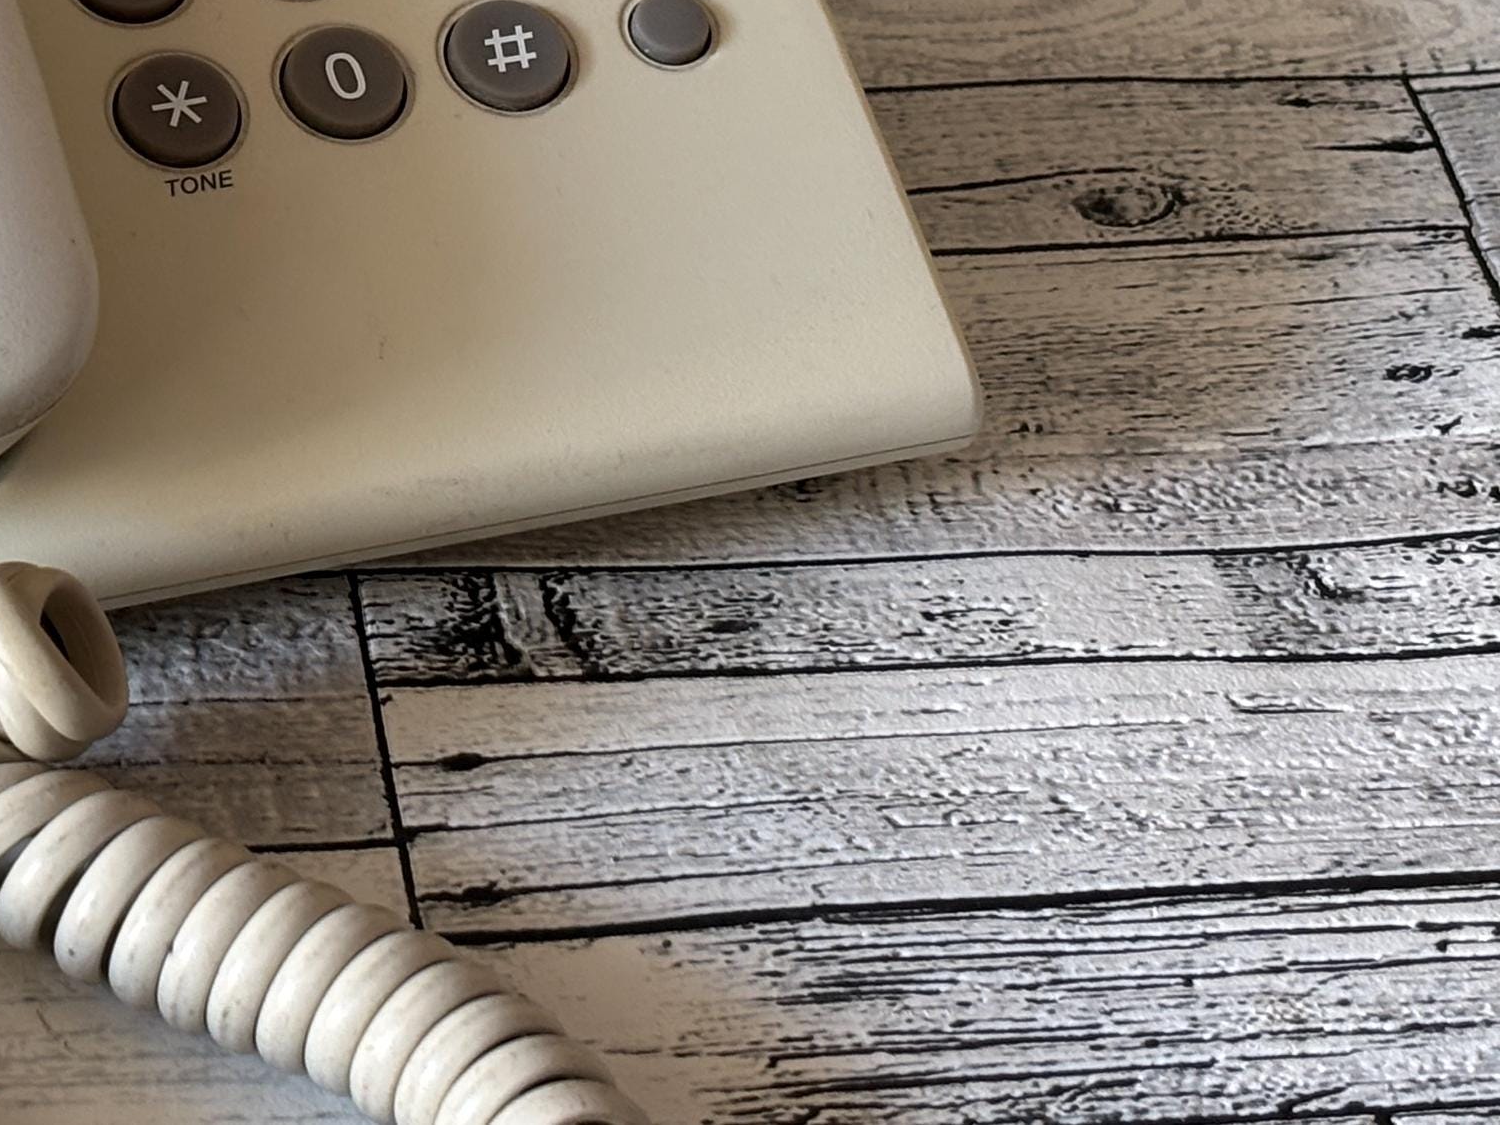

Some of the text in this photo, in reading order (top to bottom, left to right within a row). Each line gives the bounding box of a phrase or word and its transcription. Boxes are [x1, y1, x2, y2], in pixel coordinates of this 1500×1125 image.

[485, 25, 536, 72] #
[326, 53, 365, 99] 0
[165, 170, 233, 196] TONE
